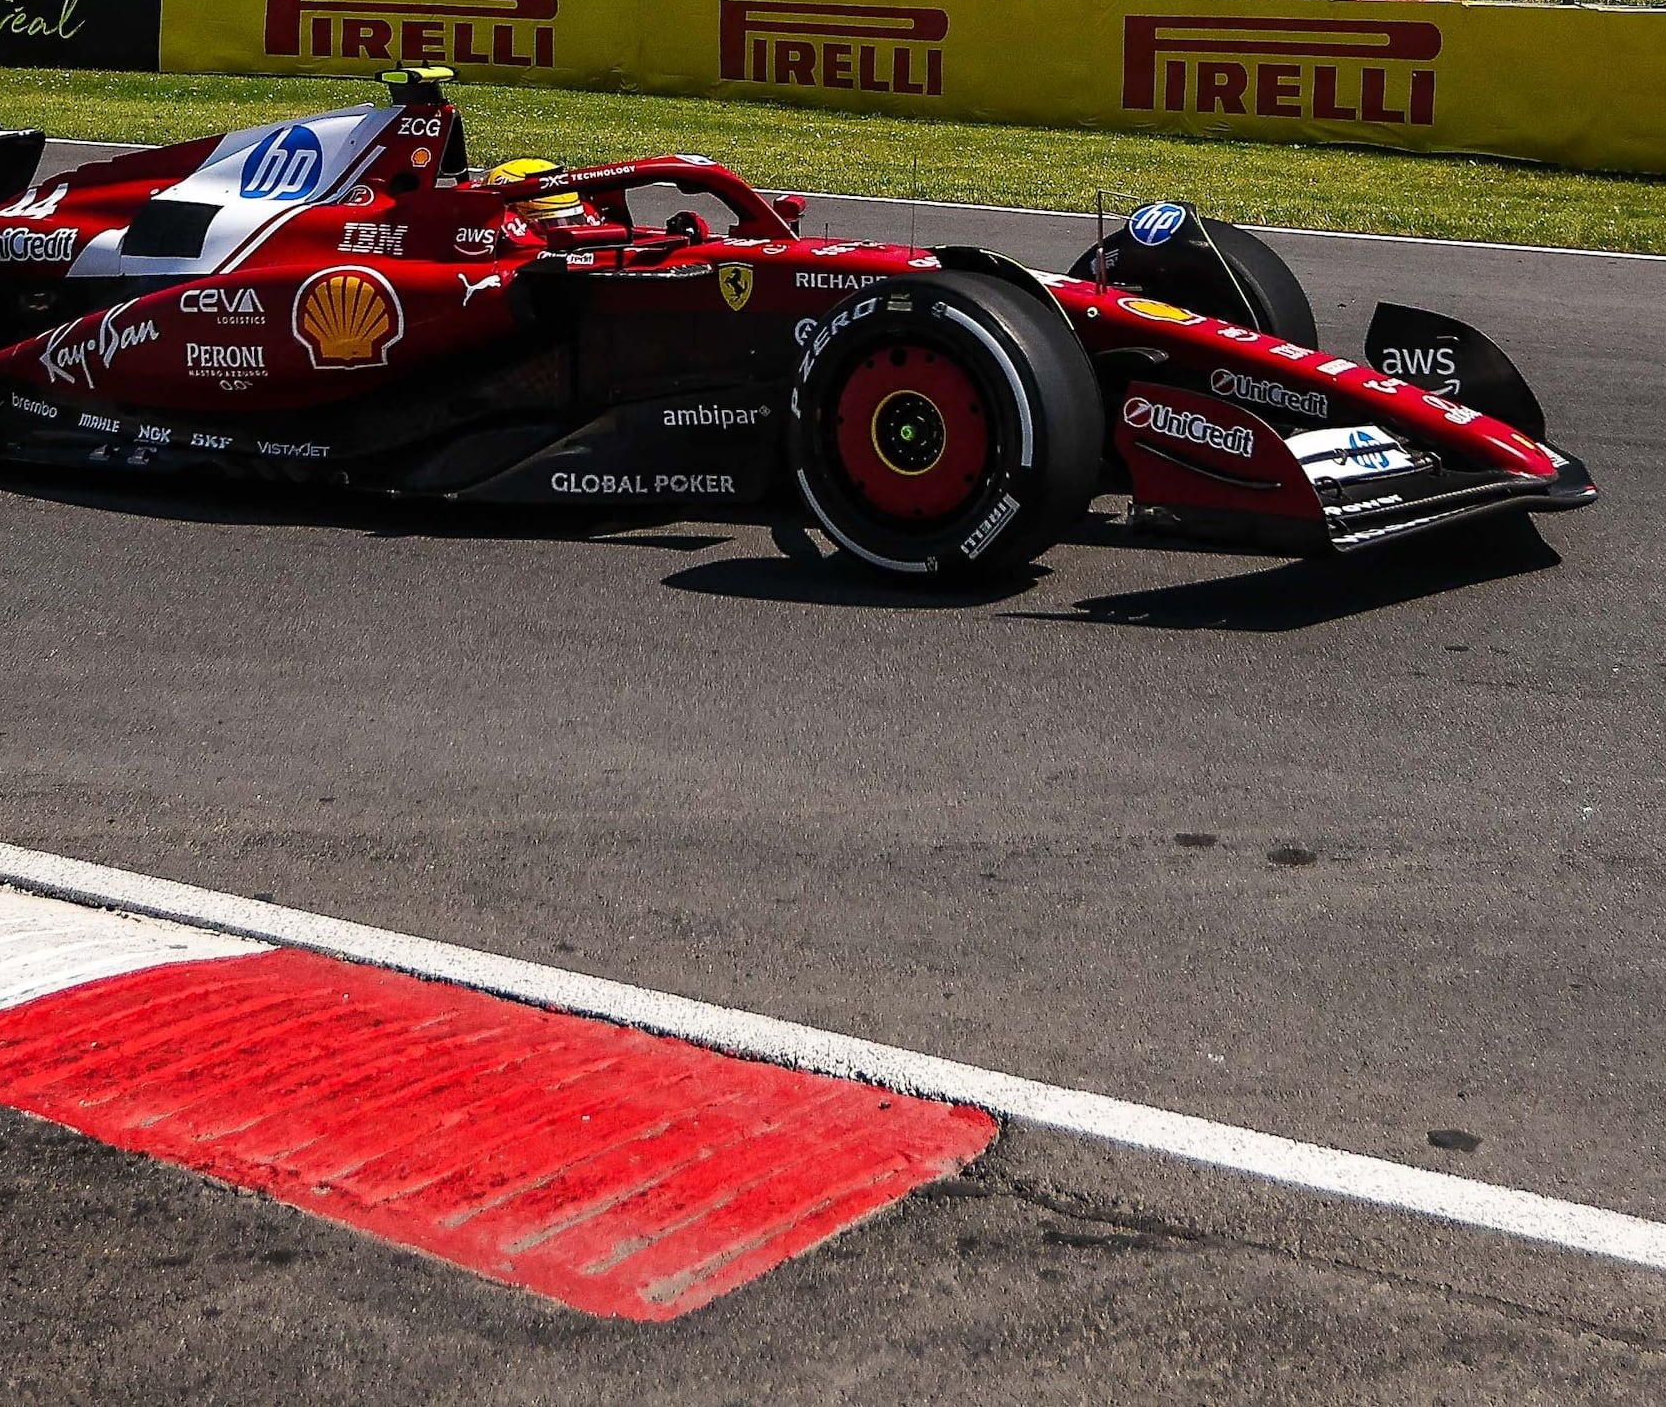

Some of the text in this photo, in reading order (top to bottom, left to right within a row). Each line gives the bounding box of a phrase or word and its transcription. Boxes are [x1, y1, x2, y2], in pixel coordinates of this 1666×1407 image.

[719, 0, 949, 95] PIRELLI
[1122, 15, 1442, 126] PIRELLI
[397, 118, 441, 137] ZCG
[241, 125, 321, 201] hp
[539, 165, 636, 190] DXC TECHNOLOGY
[455, 227, 496, 245] aws
[1131, 204, 1185, 246] hp
[337, 222, 408, 256] IBM
[217, 316, 266, 325] LOGISTICS
[798, 297, 882, 383] ZERO
[186, 343, 266, 368] PERONI
[1382, 346, 1456, 375] aws
[11, 392, 58, 418] brembo
[1235, 375, 1327, 419] UniCredit
[78, 413, 121, 433] MAHLE
[138, 425, 172, 443] NGK
[1151, 404, 1254, 457] UniCredit
[190, 433, 233, 450] SKF
[551, 473, 735, 494] GLOBAL POKER
[960, 494, 1022, 560] PIRELLI
